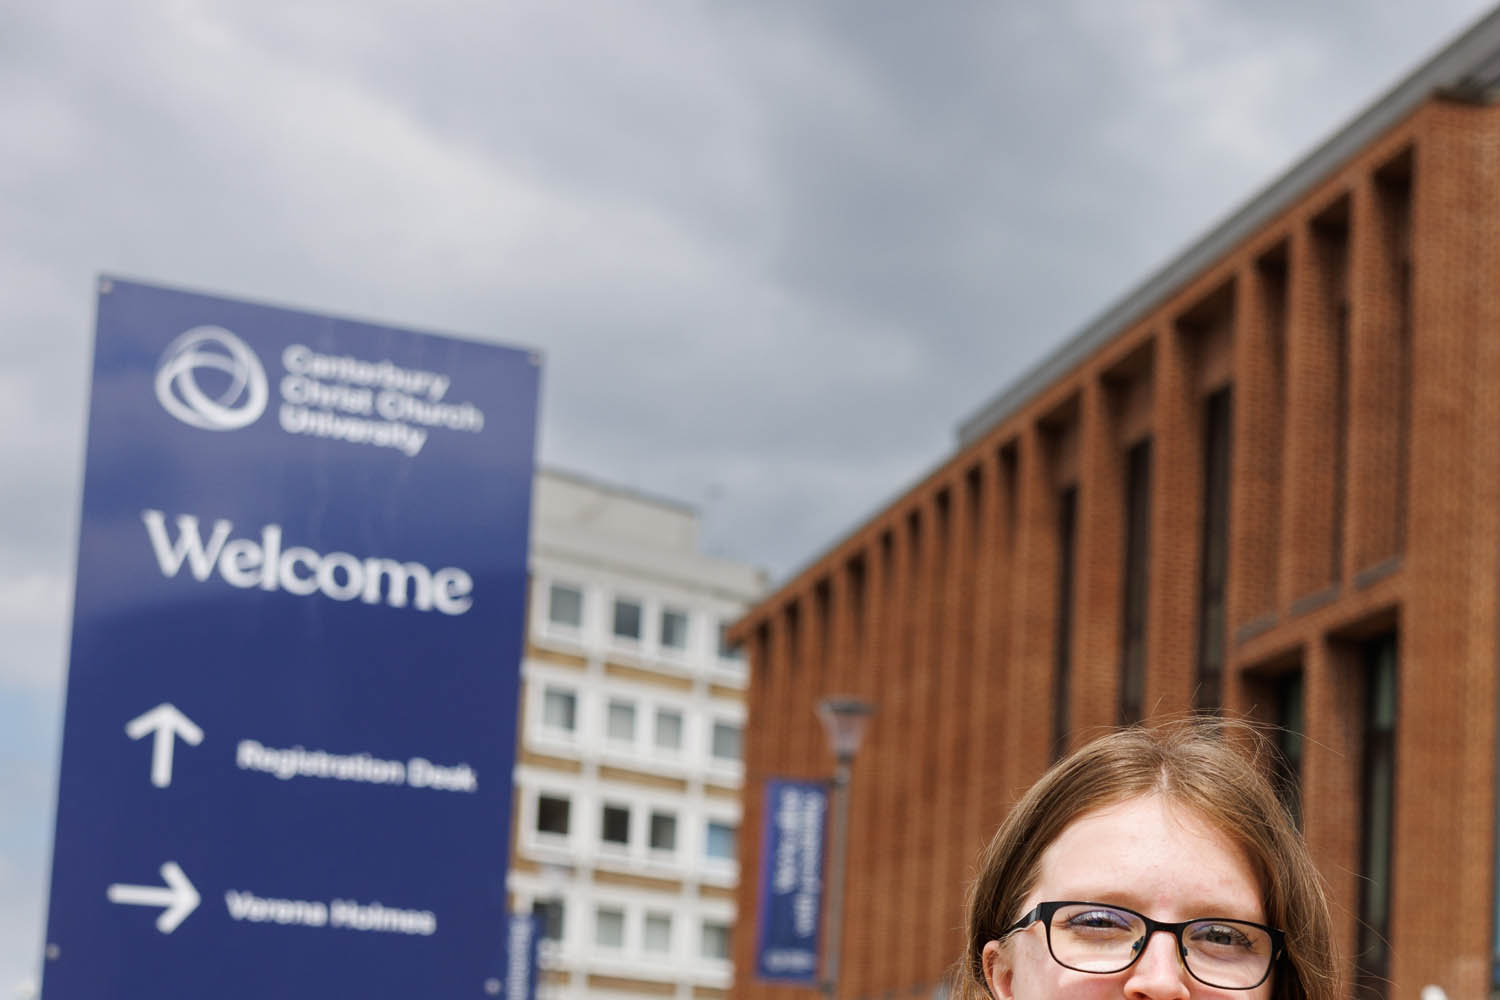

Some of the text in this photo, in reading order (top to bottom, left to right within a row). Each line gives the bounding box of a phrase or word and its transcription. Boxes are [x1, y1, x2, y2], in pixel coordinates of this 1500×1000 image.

[282, 344, 450, 403] Canterbury
[279, 401, 428, 457] University
[142, 509, 473, 615] Welcome
[237, 739, 406, 786] Registration
